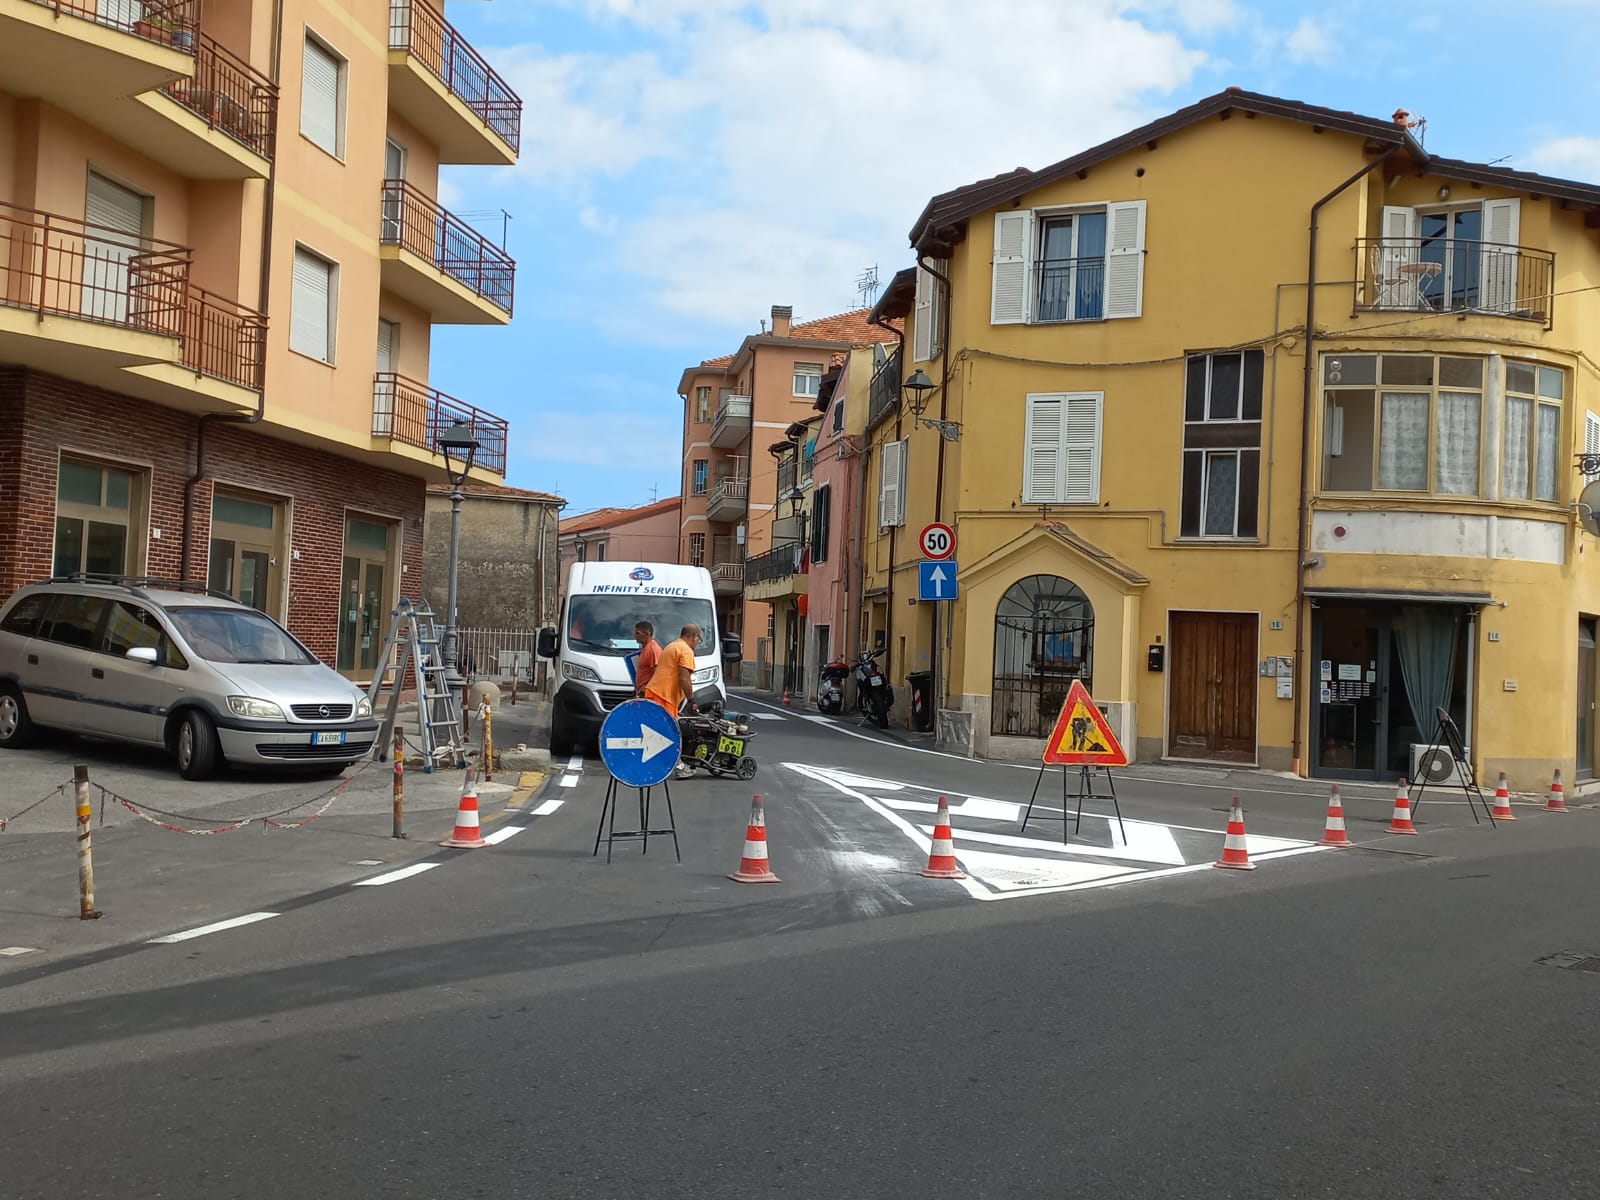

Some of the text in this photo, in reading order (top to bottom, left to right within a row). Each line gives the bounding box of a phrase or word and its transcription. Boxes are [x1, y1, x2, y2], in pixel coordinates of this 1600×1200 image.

[927, 533, 947, 550] 50
[592, 584, 689, 596] INFINITY SERVICE
